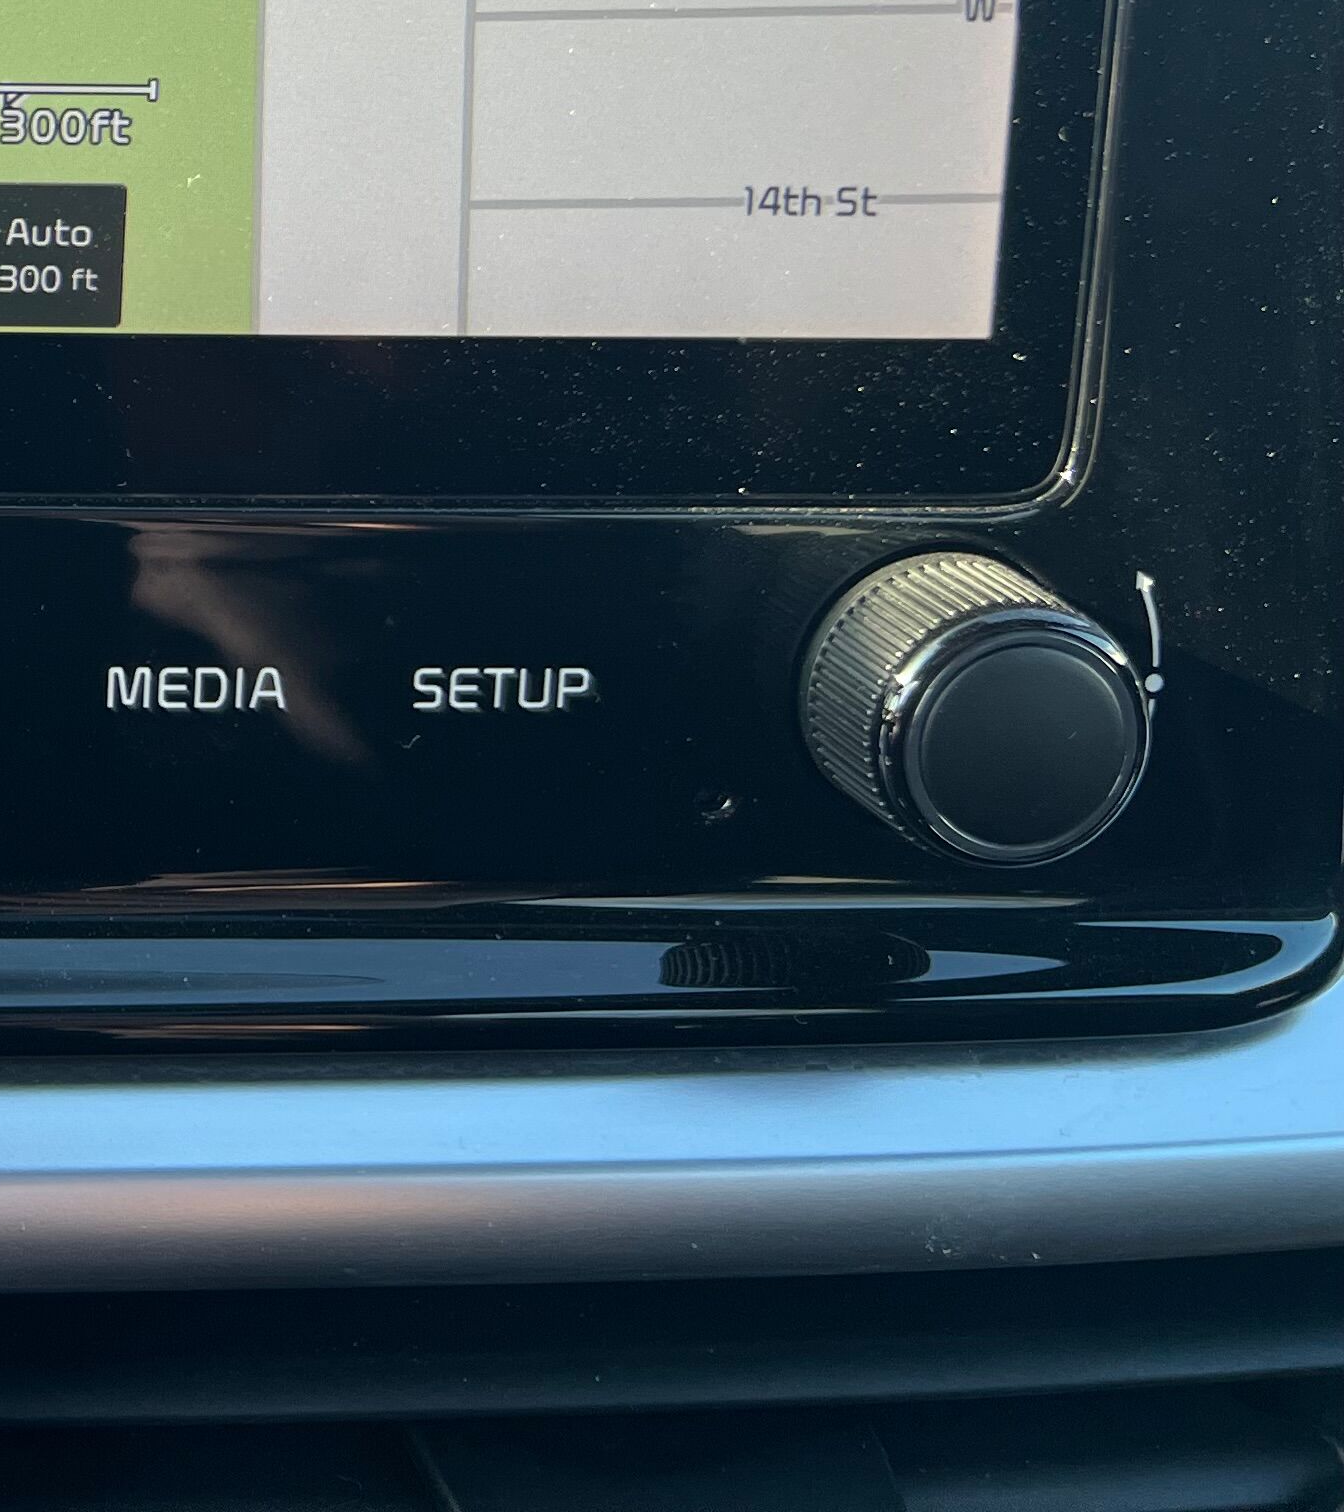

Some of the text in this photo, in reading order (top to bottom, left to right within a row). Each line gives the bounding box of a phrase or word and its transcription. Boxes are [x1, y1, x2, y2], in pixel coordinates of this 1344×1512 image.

[0, 107, 134, 146] 300ft
[743, 184, 877, 219] 14th St
[5, 217, 93, 248] Auto
[71, 268, 99, 293] ft
[107, 665, 285, 710] MEDIA
[413, 666, 592, 710] SETUP
